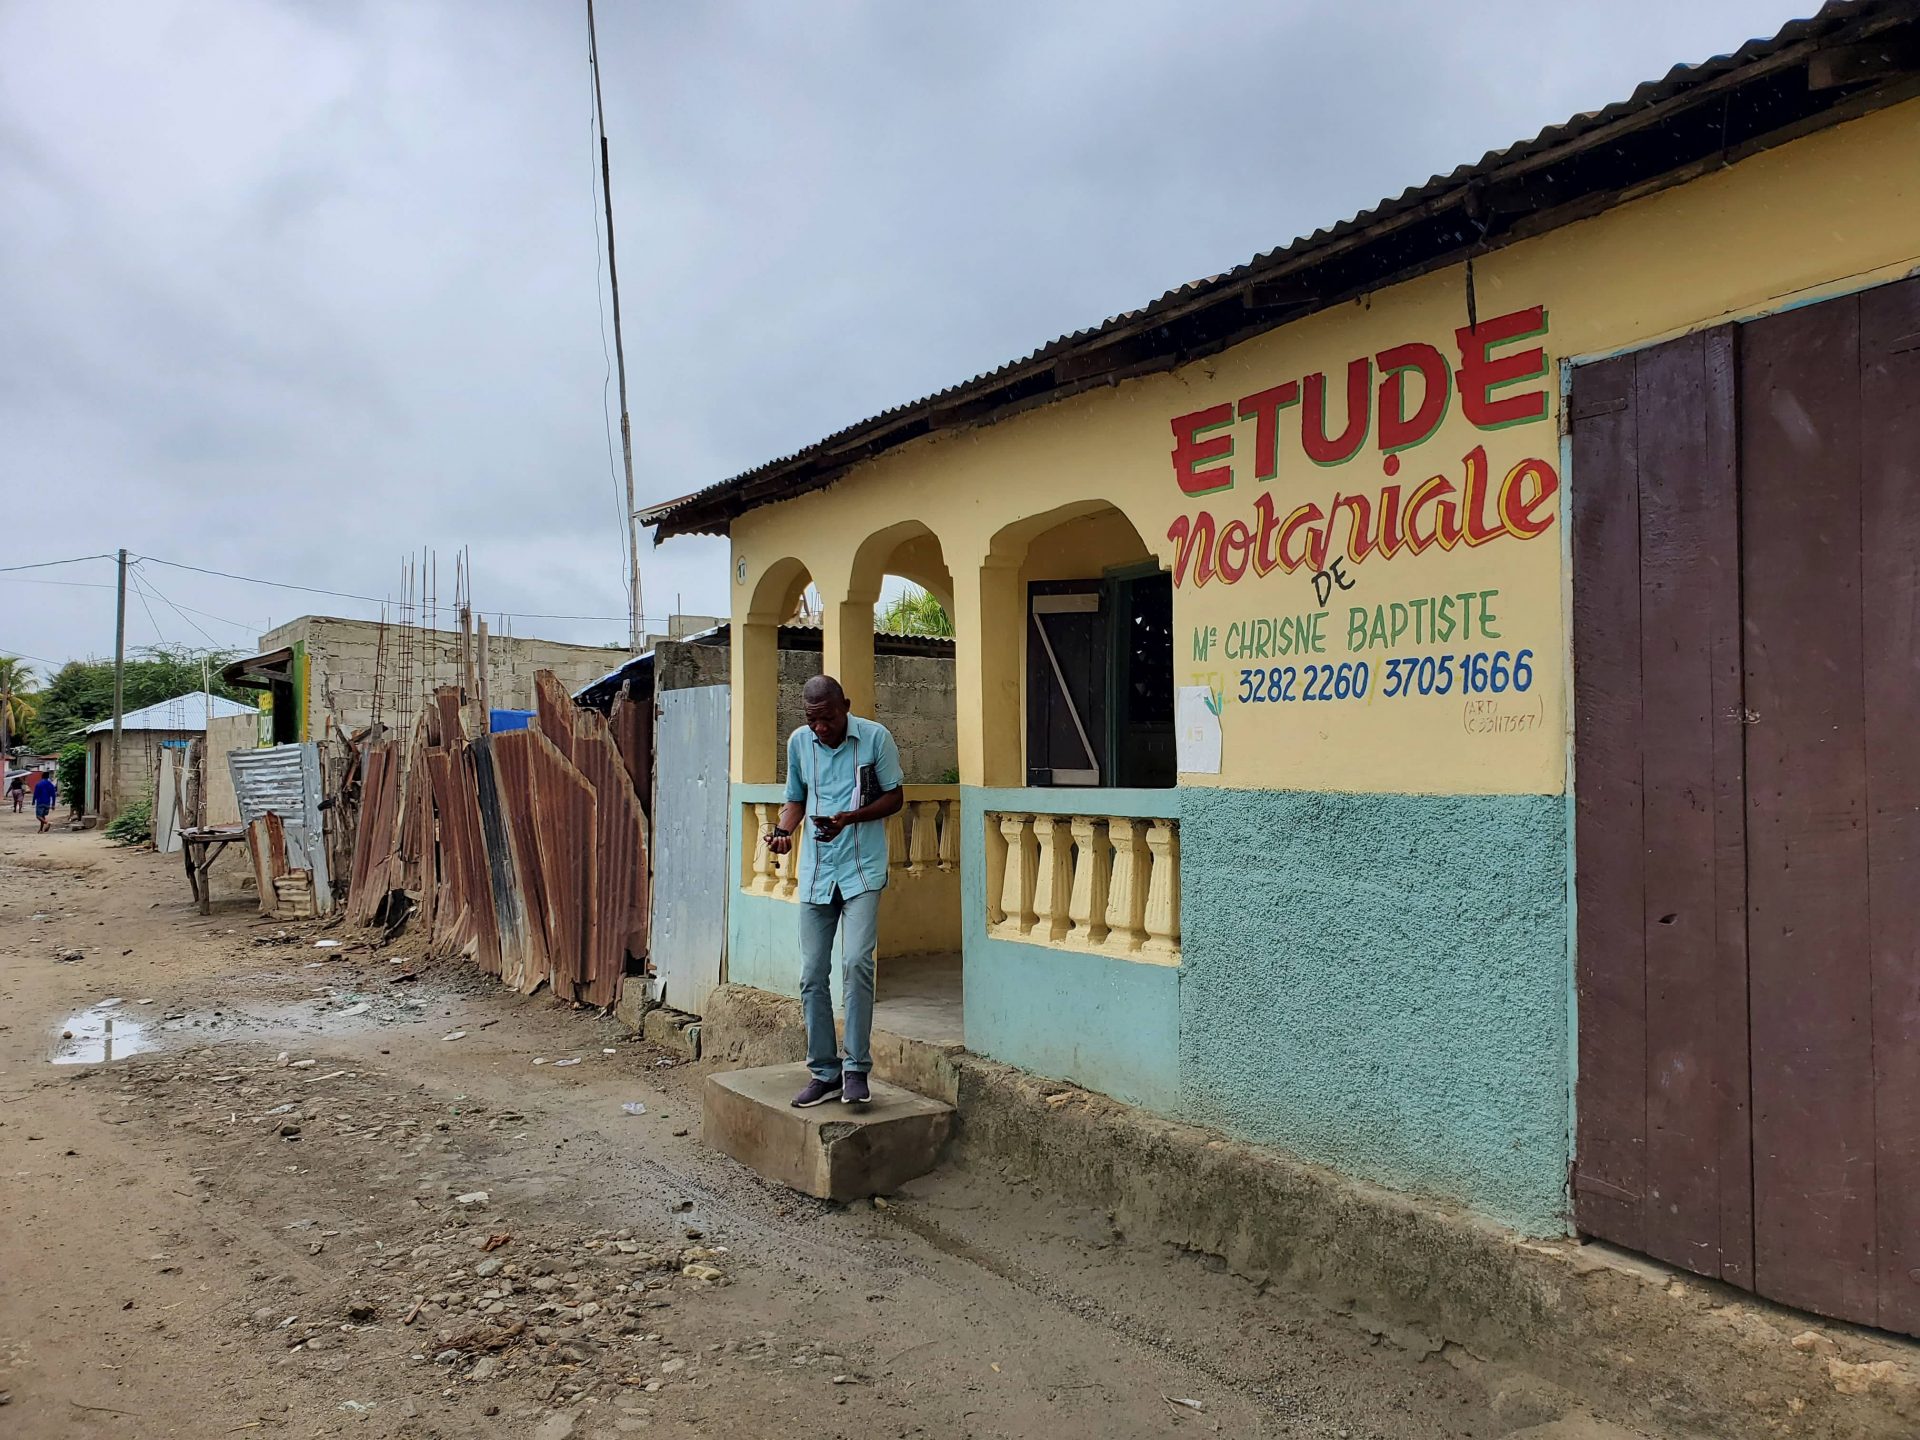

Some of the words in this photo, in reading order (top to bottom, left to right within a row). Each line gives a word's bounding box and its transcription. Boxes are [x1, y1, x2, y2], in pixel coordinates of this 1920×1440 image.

[1171, 304, 1549, 497] ETUDE
[1311, 556, 1355, 607] DE
[1224, 611, 1330, 660] CHRISNE
[1347, 589, 1501, 652] BAPTISTE
